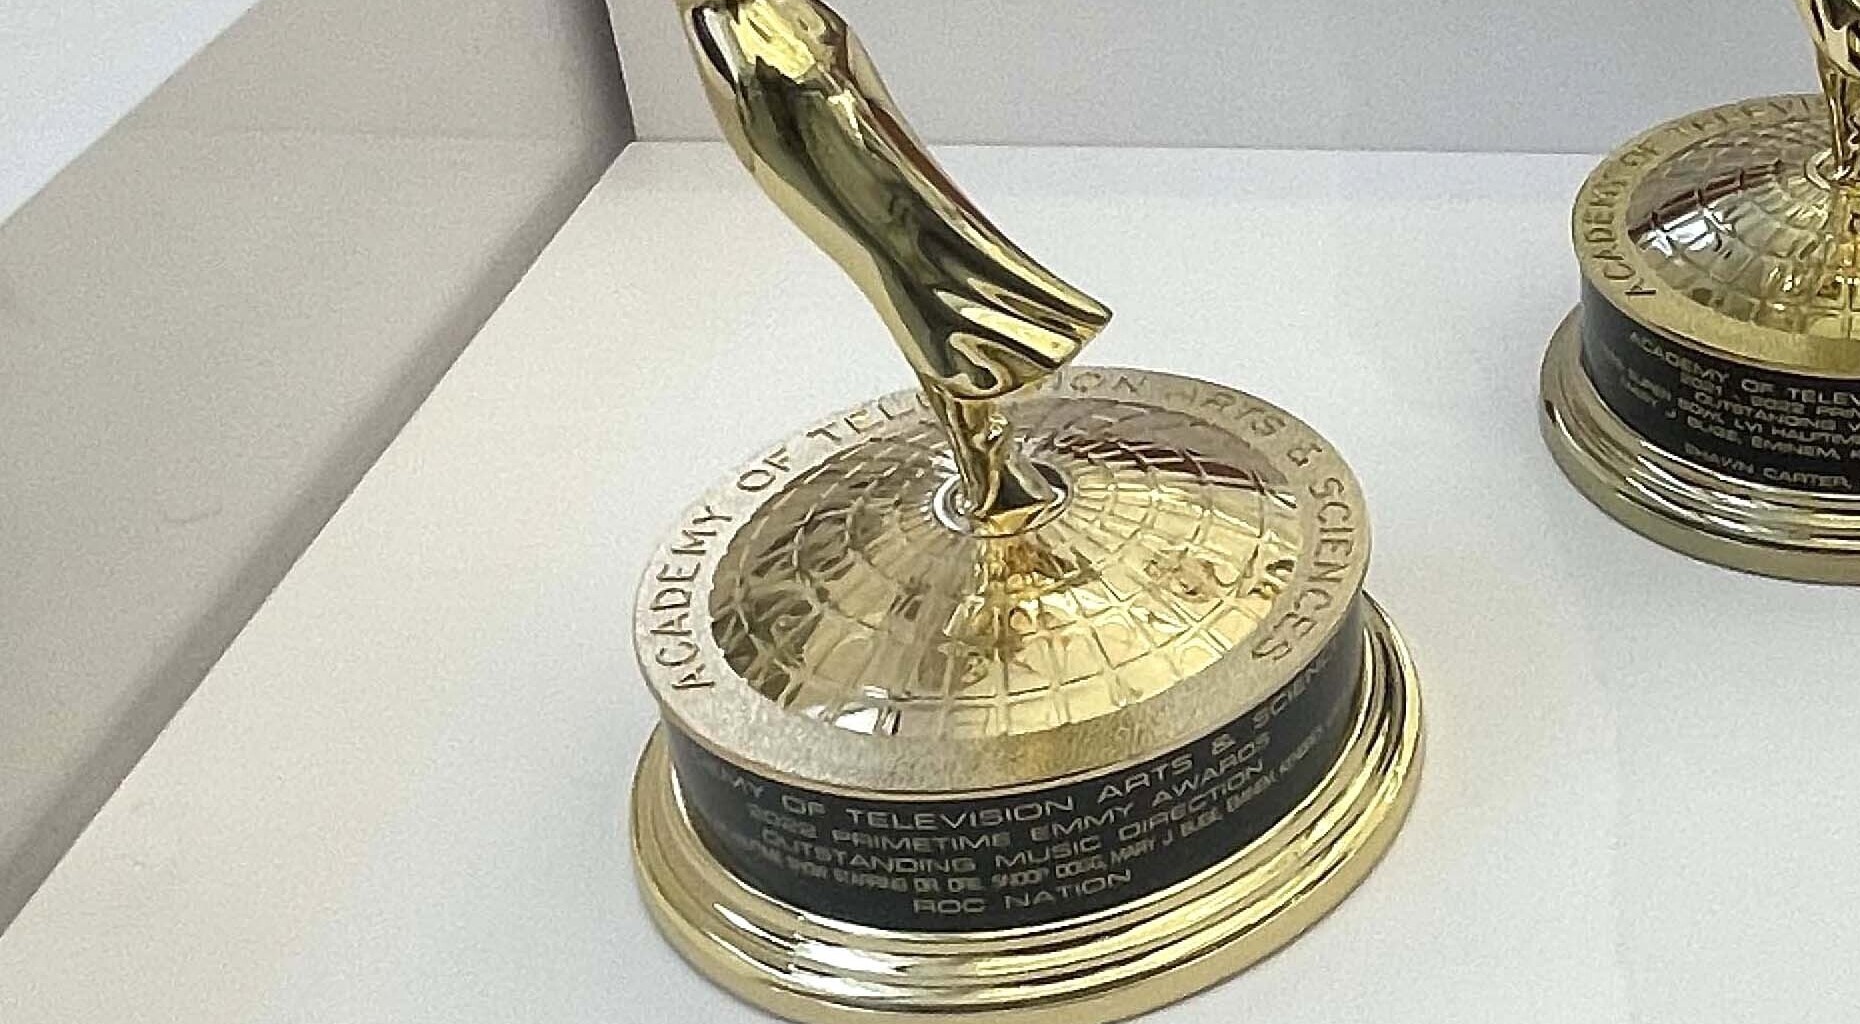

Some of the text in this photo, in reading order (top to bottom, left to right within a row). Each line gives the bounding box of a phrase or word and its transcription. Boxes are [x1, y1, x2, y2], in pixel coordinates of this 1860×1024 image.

[1630, 331, 1730, 384] ACADEMY
[1741, 379, 1776, 394] OF
[1694, 391, 1837, 431] OUTSTANDING
[649, 504, 733, 689] ACADEMY
[736, 447, 791, 492] OF
[1251, 477, 1355, 661] SCIENCES
[762, 828, 977, 873] OUTSTANDING
[995, 835, 1102, 868] MUSIC
[1118, 759, 1265, 842] DIRECTION
[781, 794, 826, 817] OF
[845, 795, 1075, 831] TELEVISION
[1098, 753, 1194, 803] ARTS
[1211, 733, 1236, 757] &
[831, 829, 1011, 853] PRIMETIME
[1031, 801, 1135, 842] EMMY
[1152, 731, 1271, 808] AWARDS
[913, 869, 1132, 915] ROC NATION
